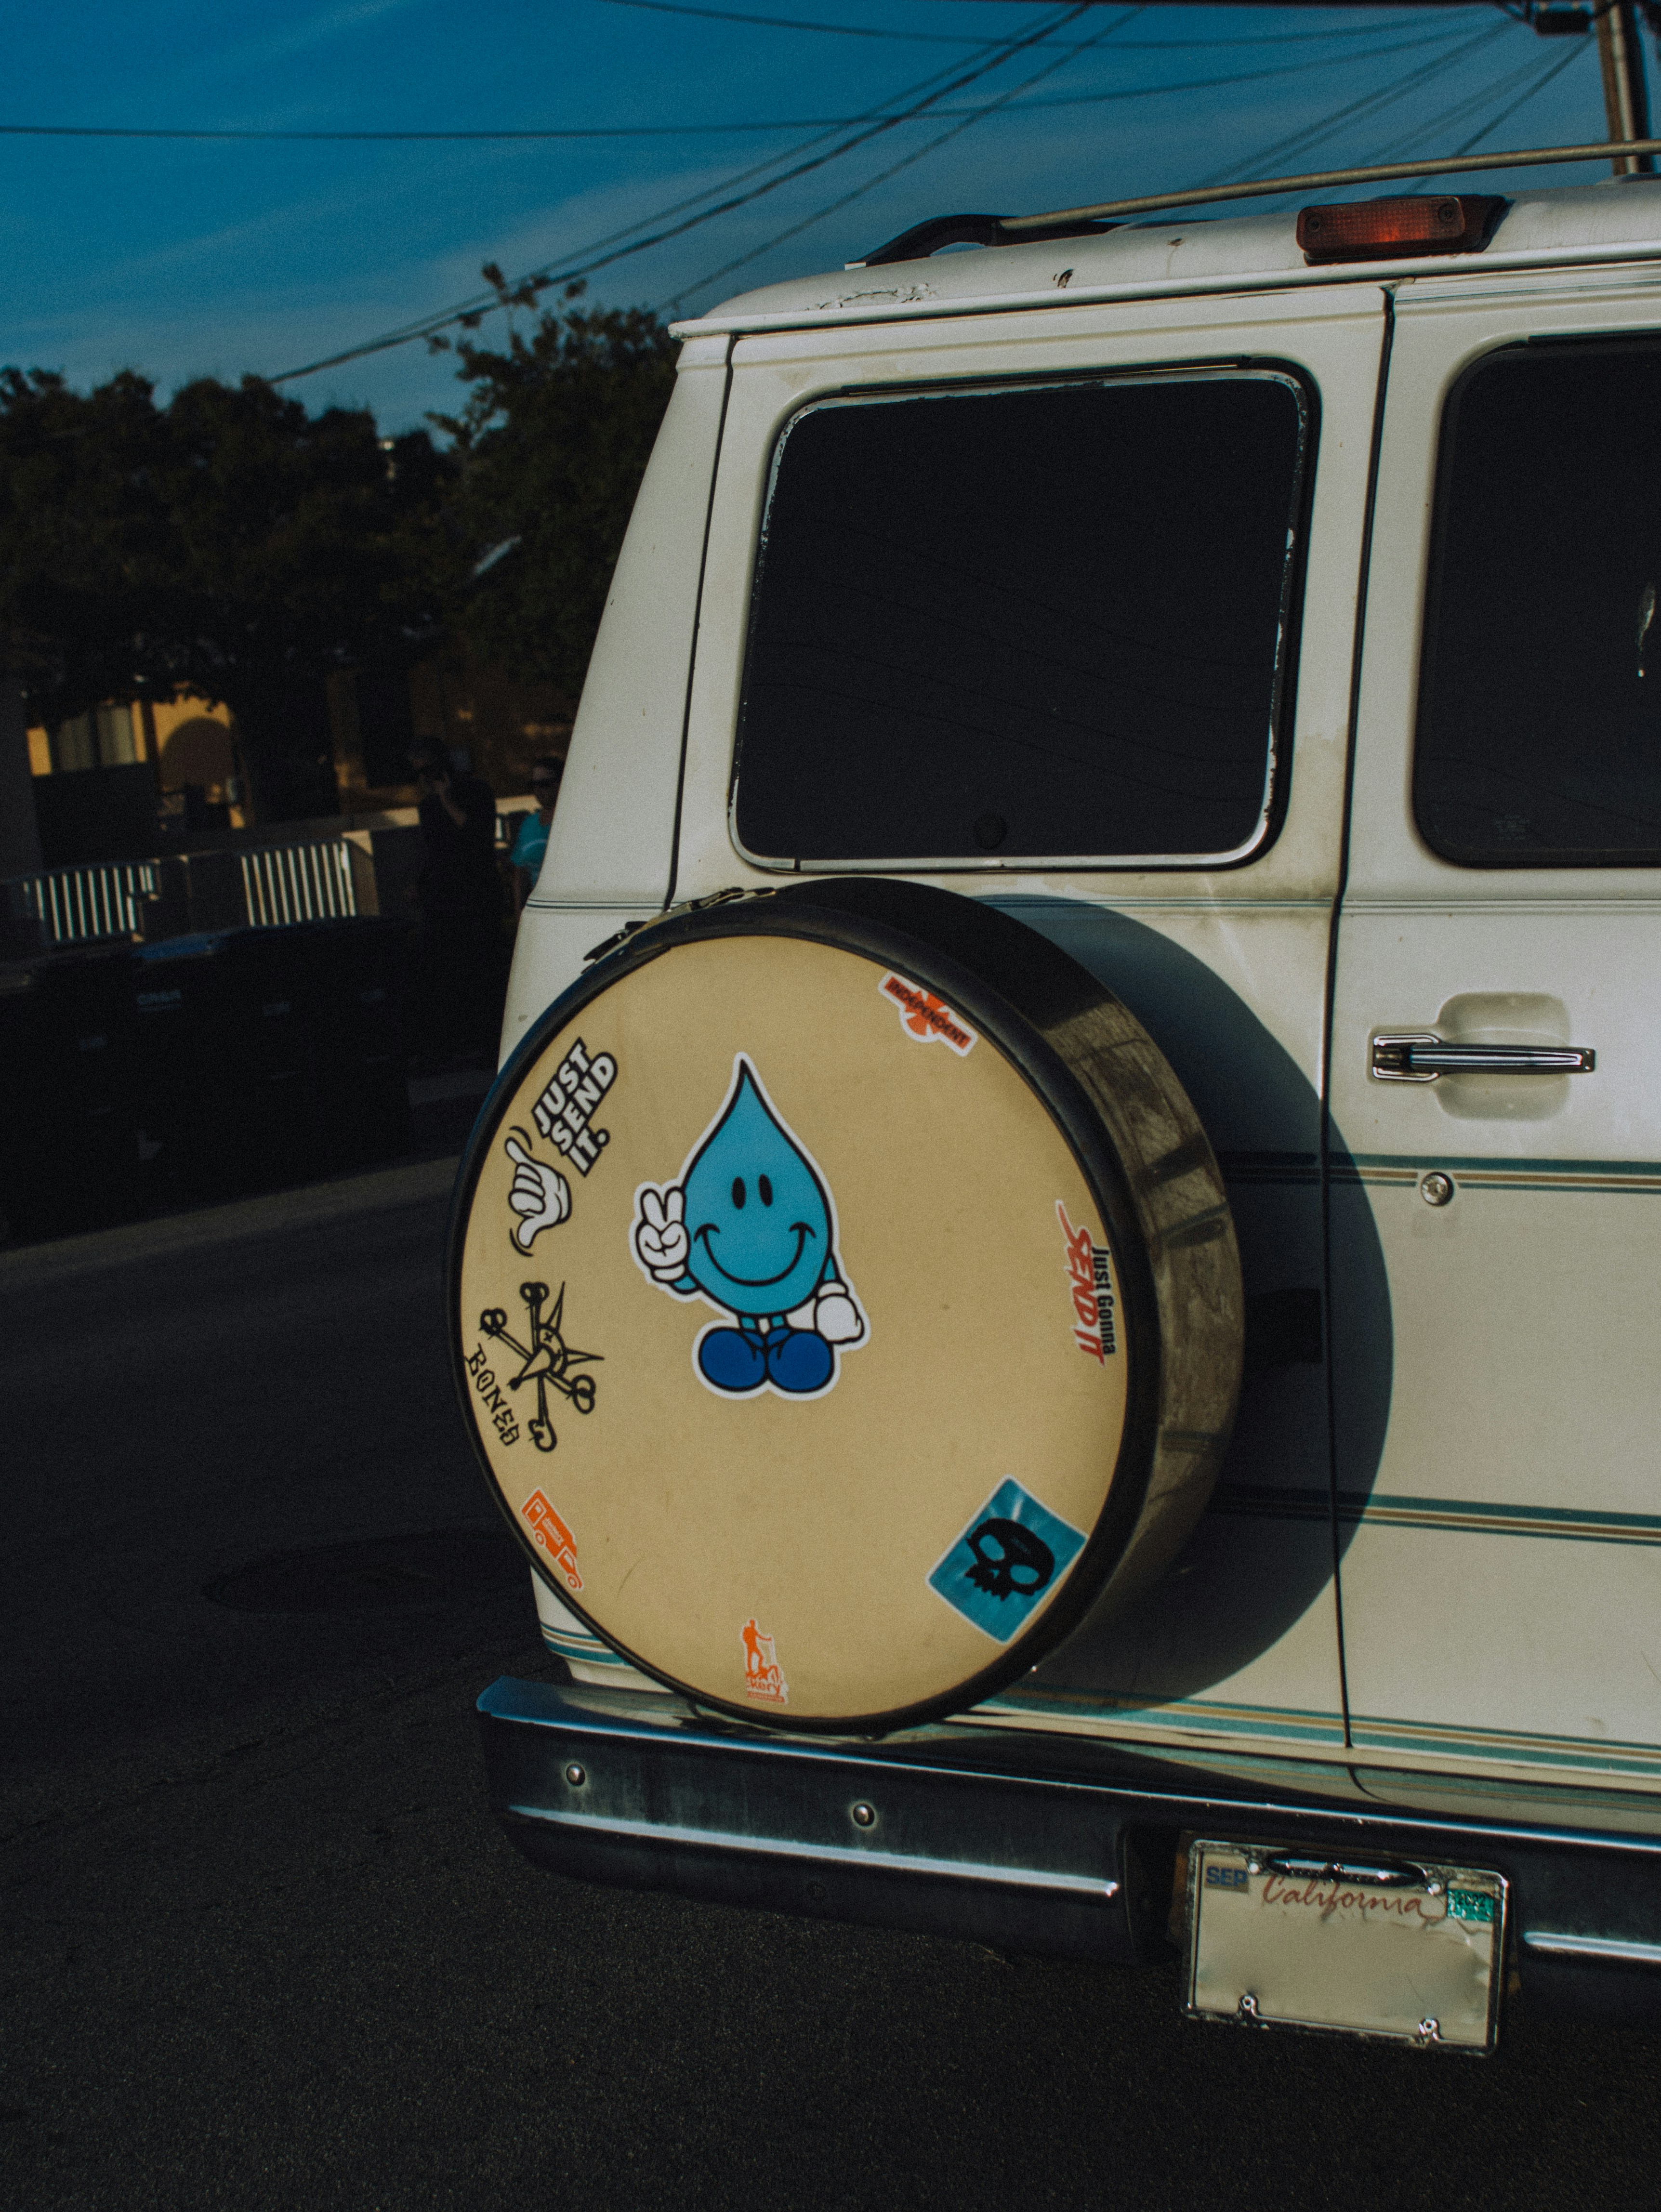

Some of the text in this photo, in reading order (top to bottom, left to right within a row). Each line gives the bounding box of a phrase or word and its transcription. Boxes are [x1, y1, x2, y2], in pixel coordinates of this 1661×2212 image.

[887, 979, 968, 1045] INDEPENDENT
[533, 1040, 590, 1137] JUST
[550, 1054, 616, 1153] SEND
[567, 1127, 608, 1173] IT.
[1058, 1204, 1106, 1366] SEND IT
[1092, 1247, 1116, 1355] Just Gonna
[1206, 1865, 1248, 1887] SEP
[1263, 1875, 1444, 1921] California
